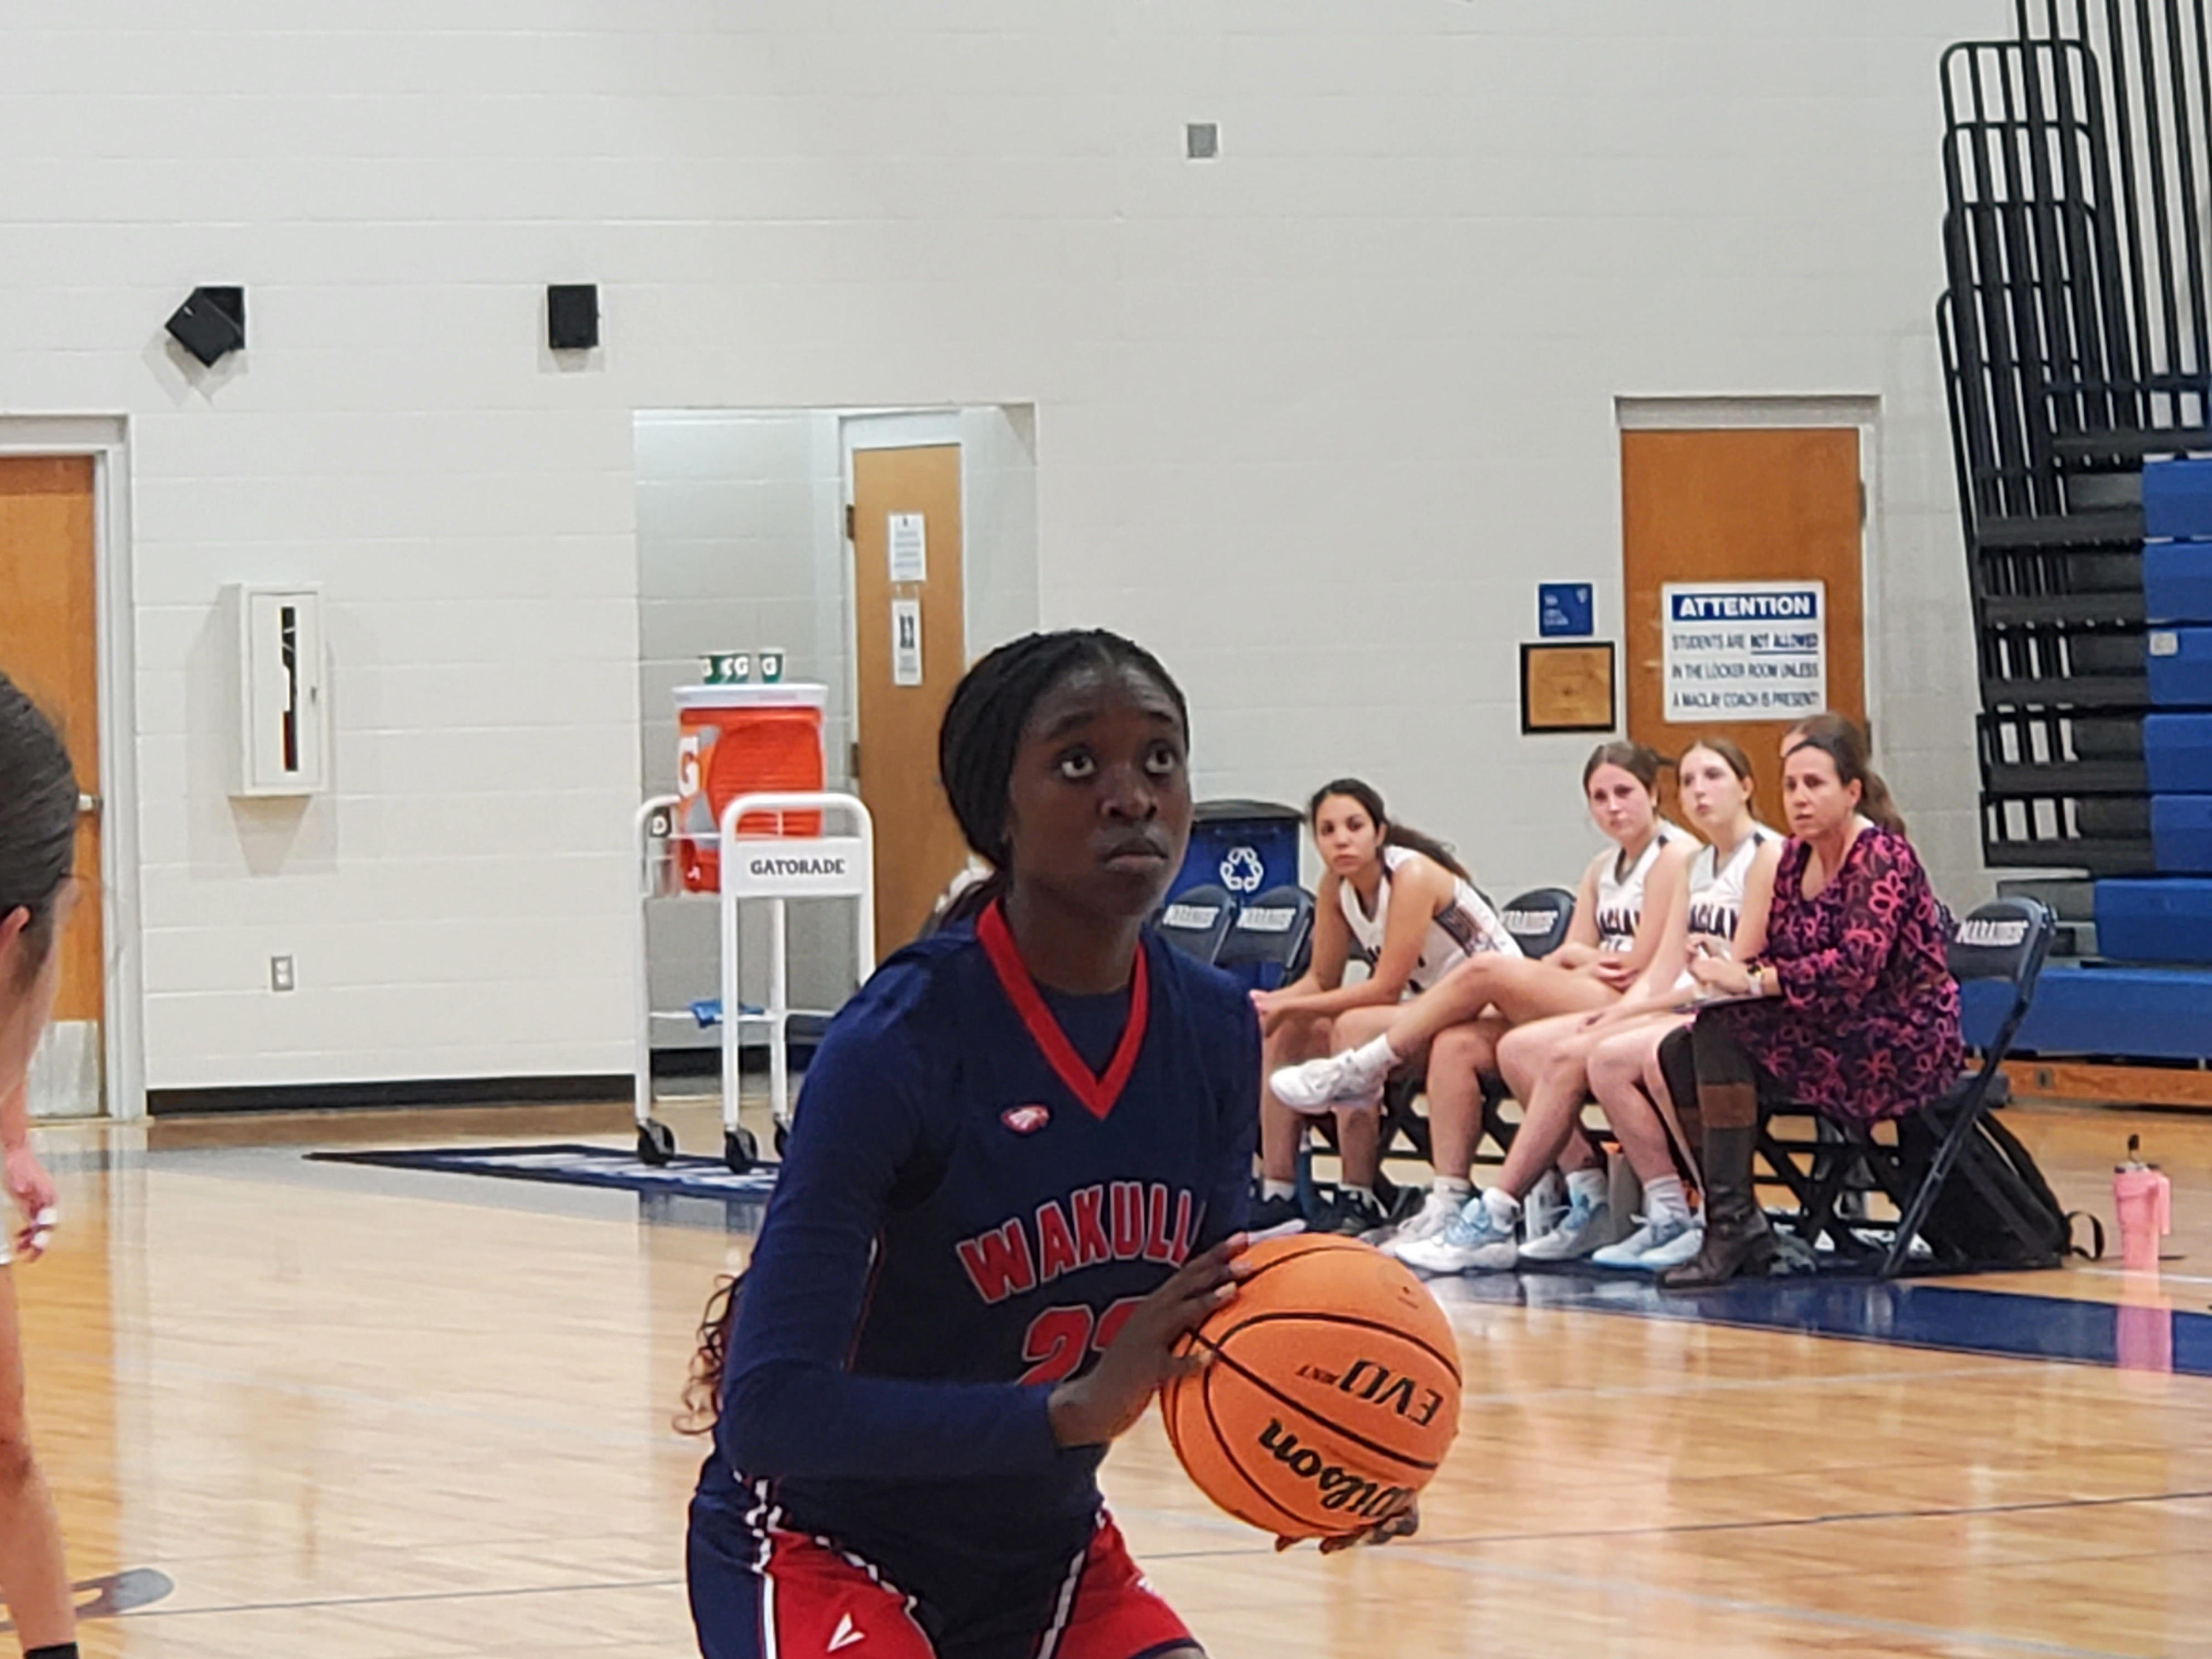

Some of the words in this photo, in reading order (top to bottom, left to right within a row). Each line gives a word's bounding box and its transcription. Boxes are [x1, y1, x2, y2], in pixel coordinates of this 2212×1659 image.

[1679, 595, 1810, 617] ATTENTION
[1673, 634, 1723, 650] STUDENTS
[1750, 632, 1768, 648] NOT
[1773, 632, 1818, 648] ALLOWED
[762, 656, 777, 676] G
[1748, 663, 1778, 678] ROOM
[750, 859, 845, 875] GATORADE
[955, 1180, 1207, 1304] WAKULL
[1014, 1295, 1153, 1386] 2
[1339, 1358, 1444, 1427] EVO
[1257, 1417, 1417, 1518] Wilson
